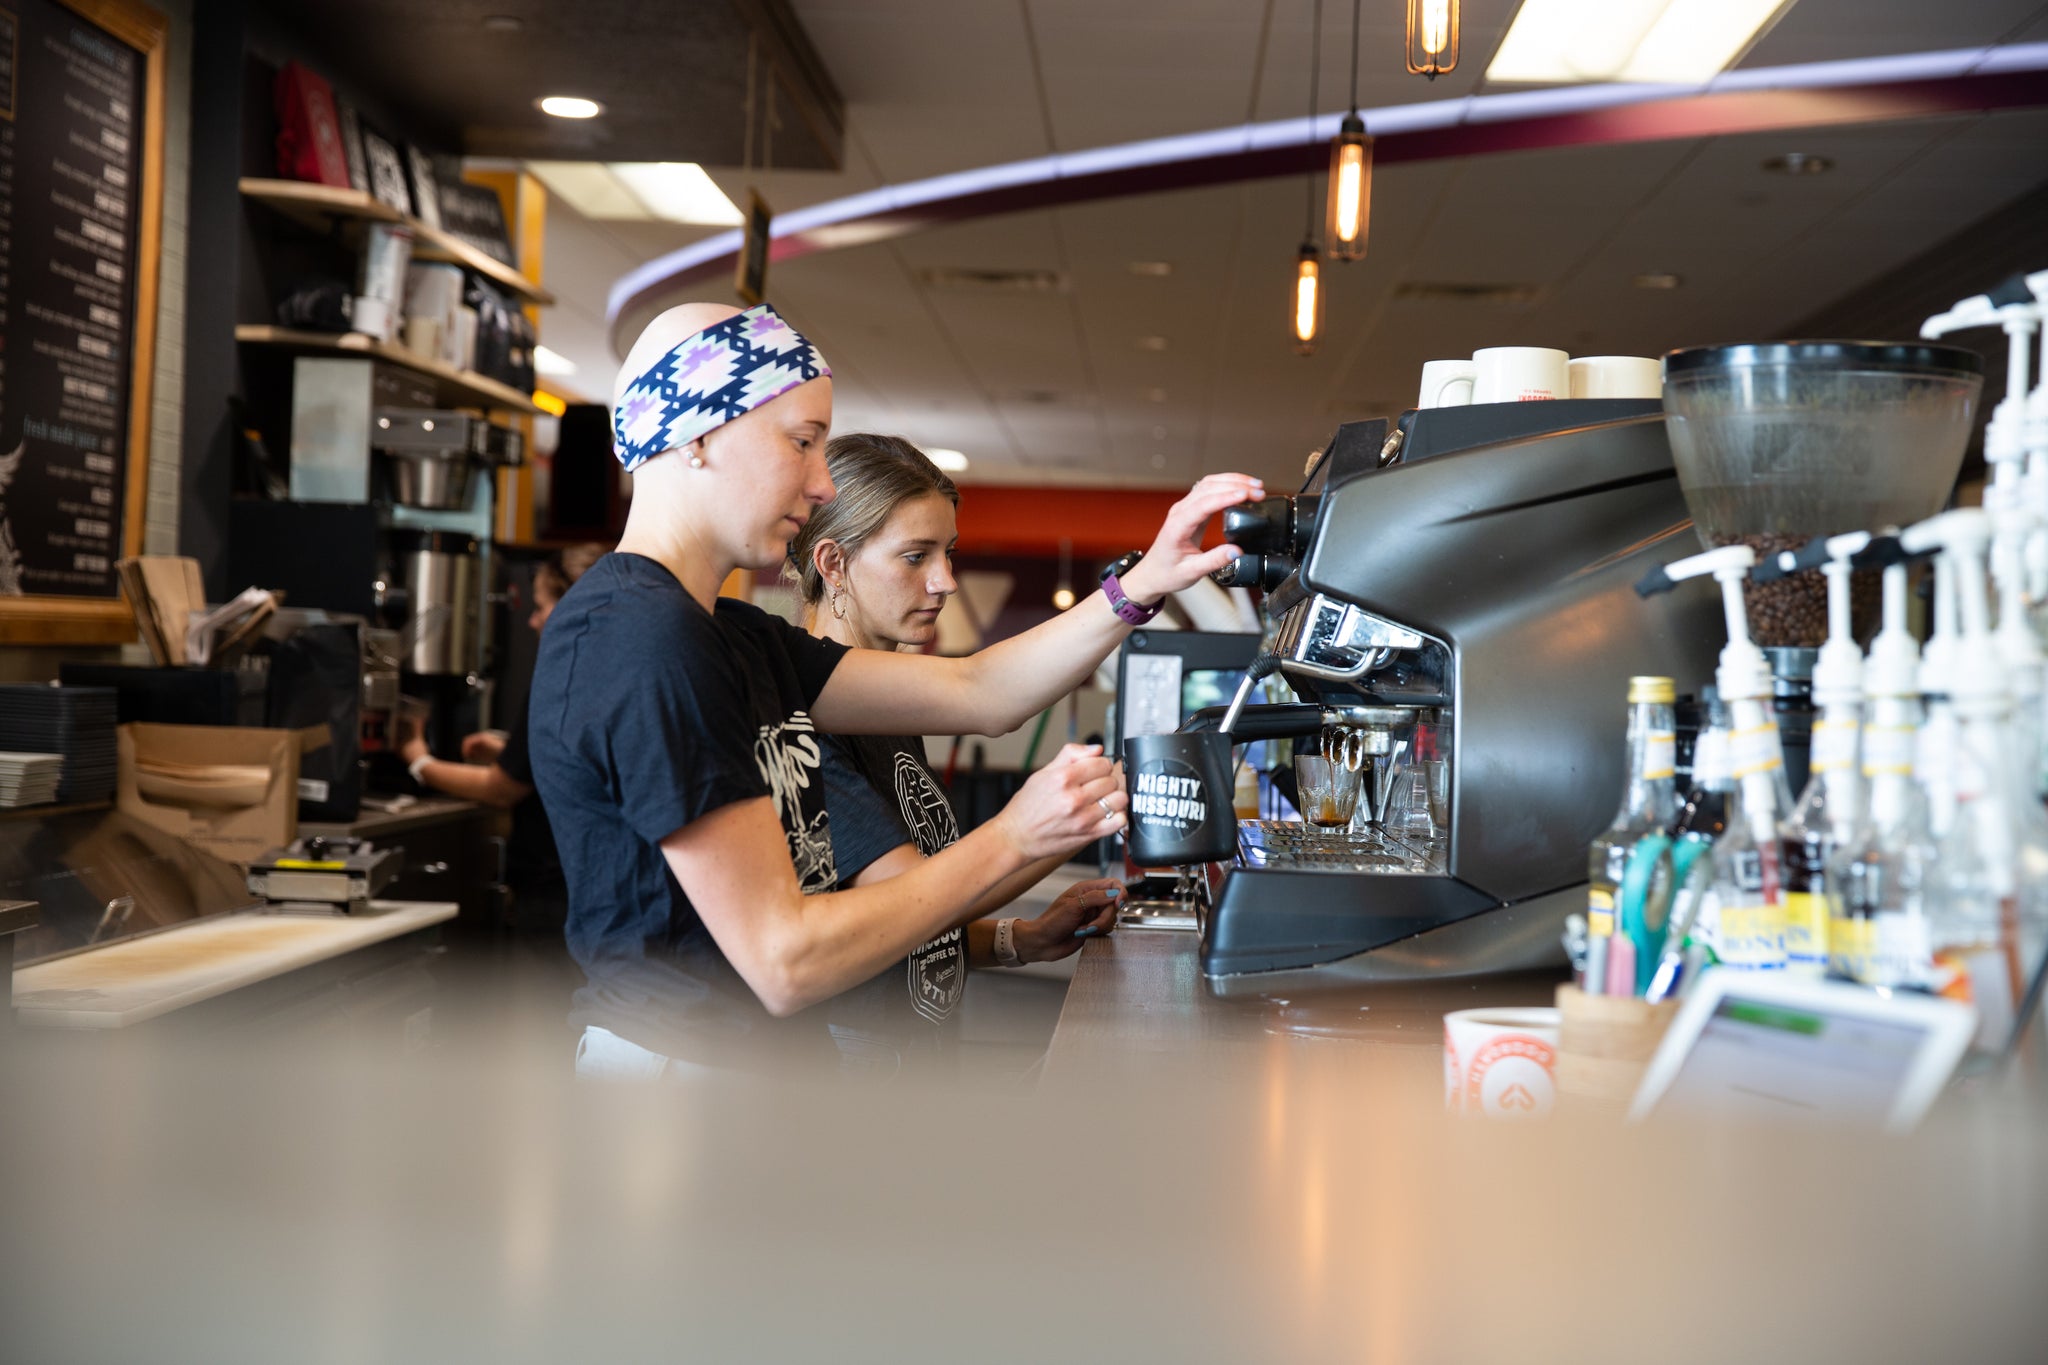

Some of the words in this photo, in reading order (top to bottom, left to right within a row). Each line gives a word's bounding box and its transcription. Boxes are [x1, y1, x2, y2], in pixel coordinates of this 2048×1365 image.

[1137, 773, 1201, 798] MIGHTY
[1132, 793, 1205, 821] MISSOURI
[1142, 816, 1172, 827] COFFEE
[926, 949, 948, 964] COFFEE
